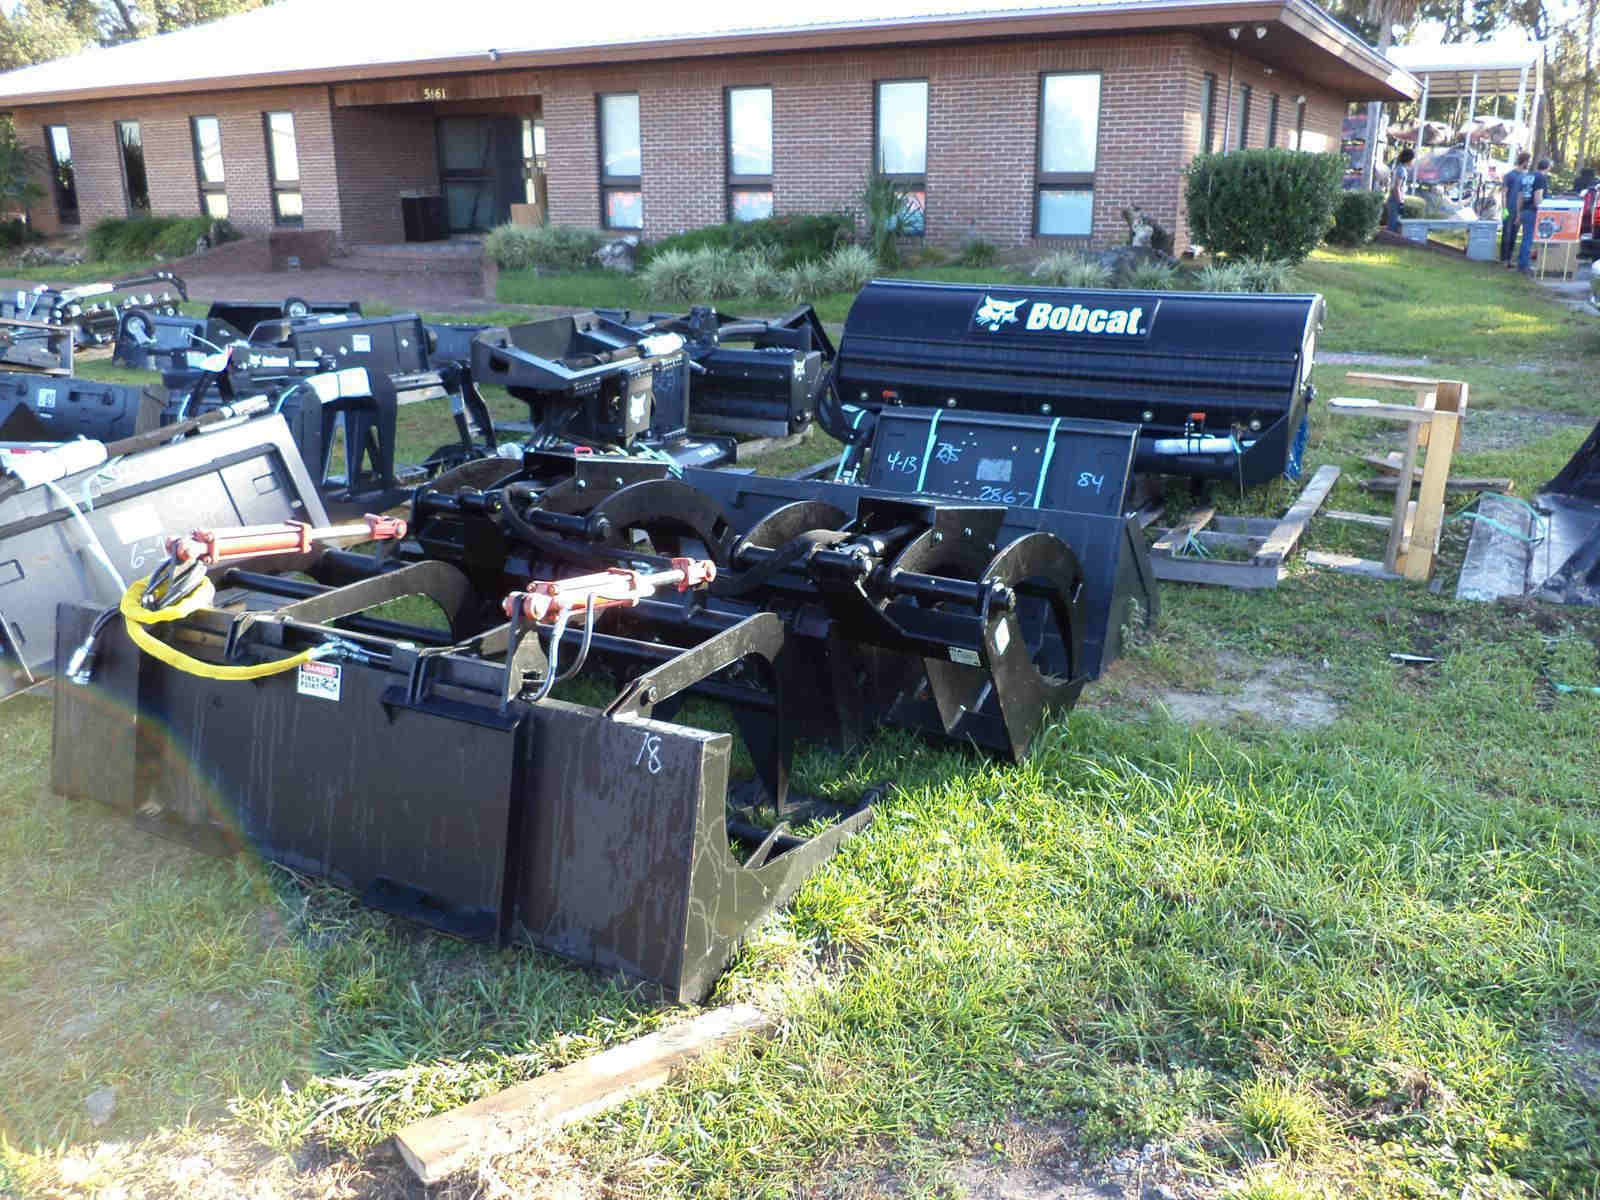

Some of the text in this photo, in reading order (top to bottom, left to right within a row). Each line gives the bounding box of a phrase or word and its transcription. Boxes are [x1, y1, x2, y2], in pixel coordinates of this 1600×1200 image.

[423, 87, 447, 100] 5161
[1026, 302, 1142, 334] Bobcat
[1077, 472, 1105, 495] 84
[980, 485, 1033, 507] 2867
